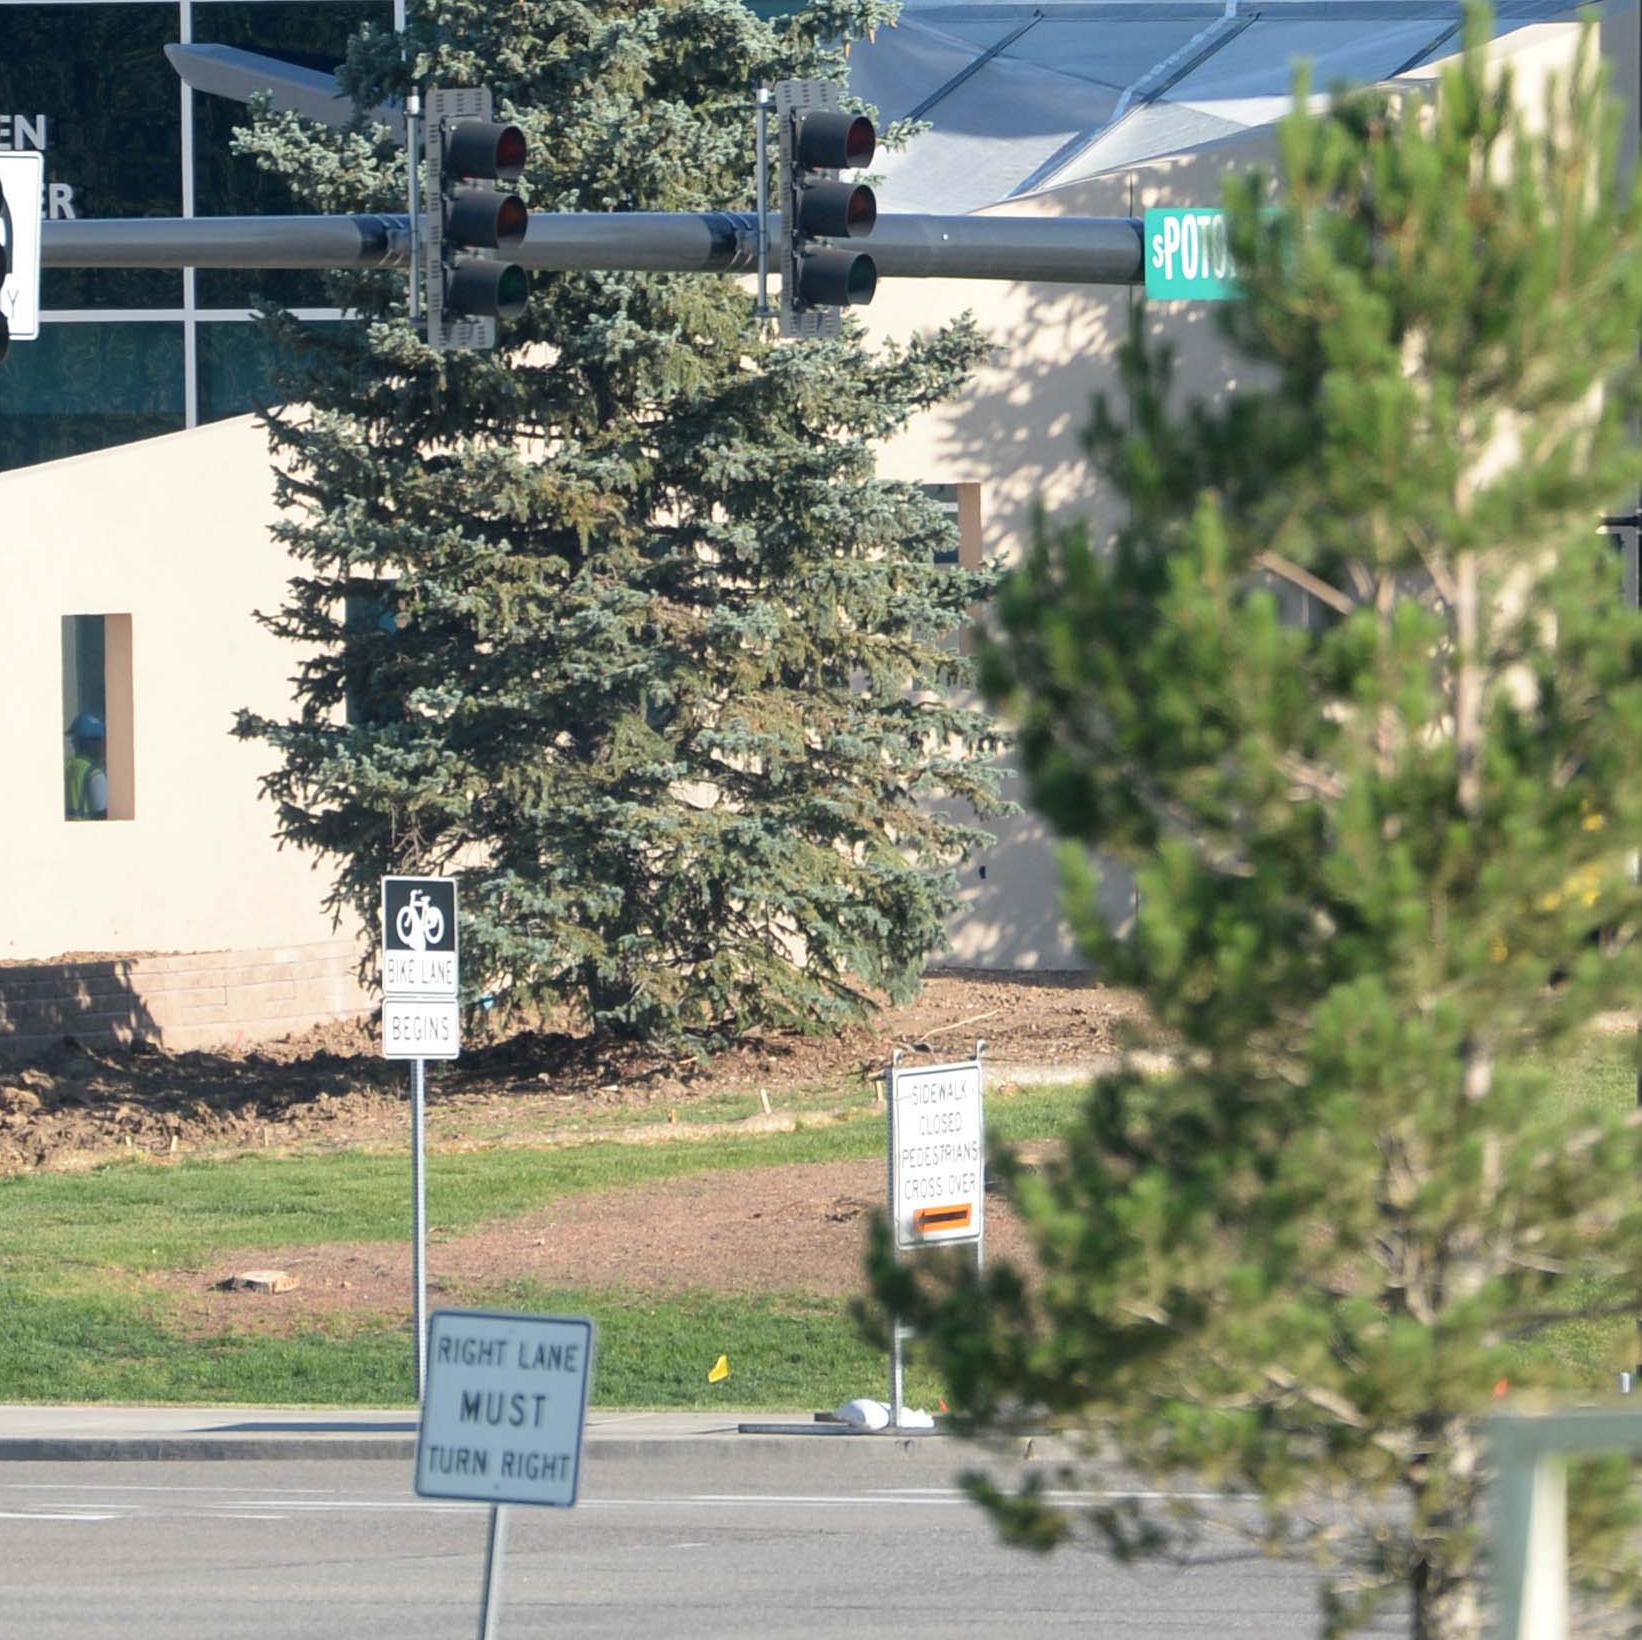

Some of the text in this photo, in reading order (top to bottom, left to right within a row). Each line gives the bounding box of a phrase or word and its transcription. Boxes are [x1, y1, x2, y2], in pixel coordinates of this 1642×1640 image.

[388, 959, 452, 984] BIKE LANE
[393, 1016, 449, 1040] BEGINS
[912, 1080, 967, 1105] SIDEWALK
[919, 1111, 962, 1135] CLOSED
[902, 1141, 977, 1168] PEDESTRIANS
[904, 1173, 975, 1200] CROSS OVER
[438, 1337, 578, 1373] RIGHT LANE
[459, 1390, 546, 1428] MUST
[428, 1446, 570, 1482] TURN RIGHT
